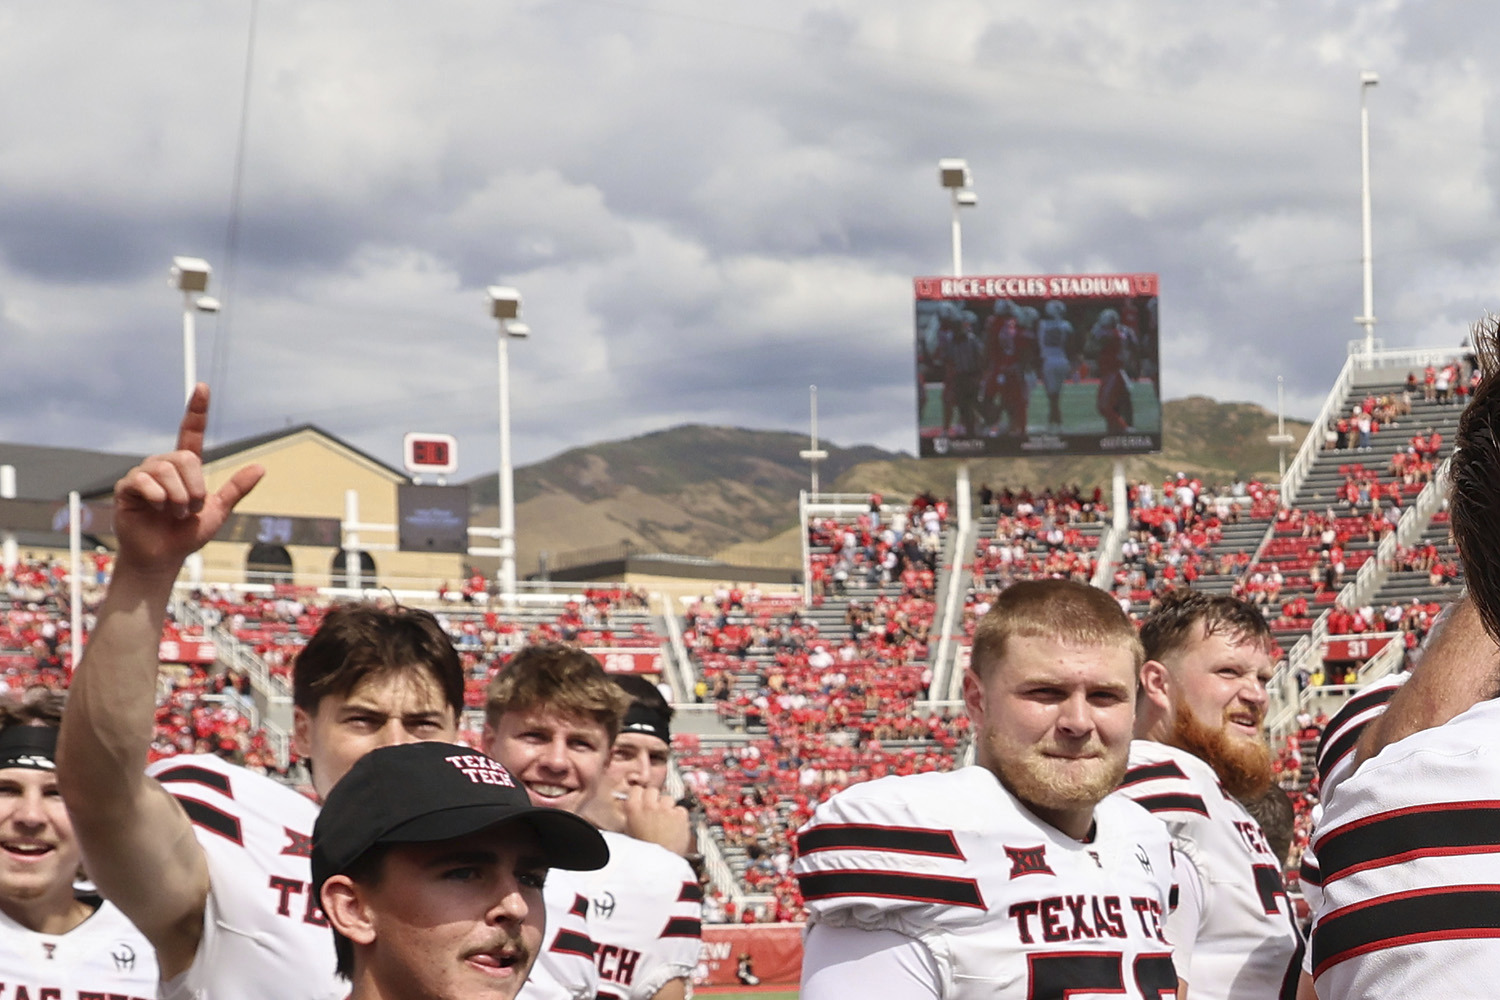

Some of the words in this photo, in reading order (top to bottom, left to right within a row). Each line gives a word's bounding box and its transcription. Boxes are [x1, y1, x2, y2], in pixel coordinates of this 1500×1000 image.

[941, 278, 1047, 297] RICE-ECCLES
[1050, 277, 1130, 296] STADIUM
[1347, 641, 1368, 658] 31
[605, 654, 634, 671] 26
[461, 768, 516, 788] TECH
[1008, 894, 1127, 946] TEXAS
